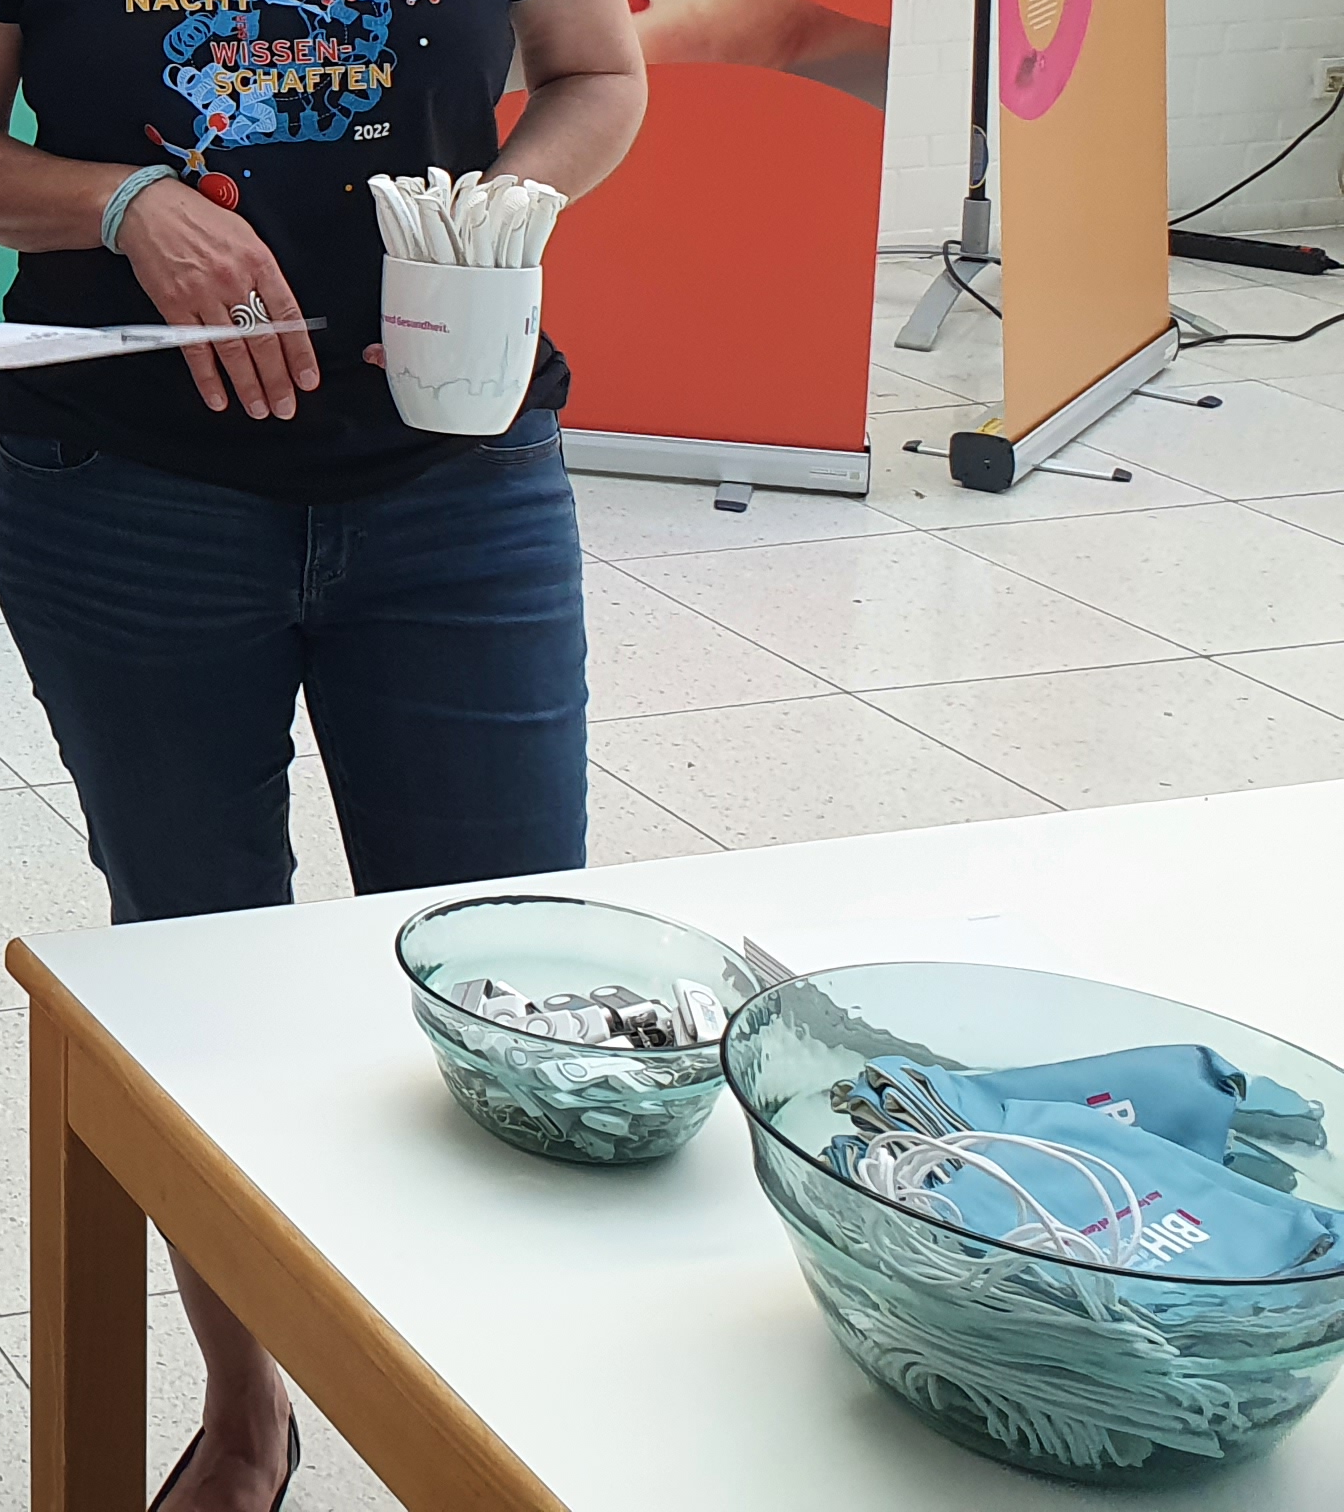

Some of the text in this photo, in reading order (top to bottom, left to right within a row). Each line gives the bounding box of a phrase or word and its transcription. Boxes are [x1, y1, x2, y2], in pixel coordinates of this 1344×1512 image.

[211, 38, 352, 68] WISSEN-
[214, 63, 392, 96] SCHAFTEN
[353, 122, 391, 141] 2022
[1138, 1212, 1211, 1263] BIH
